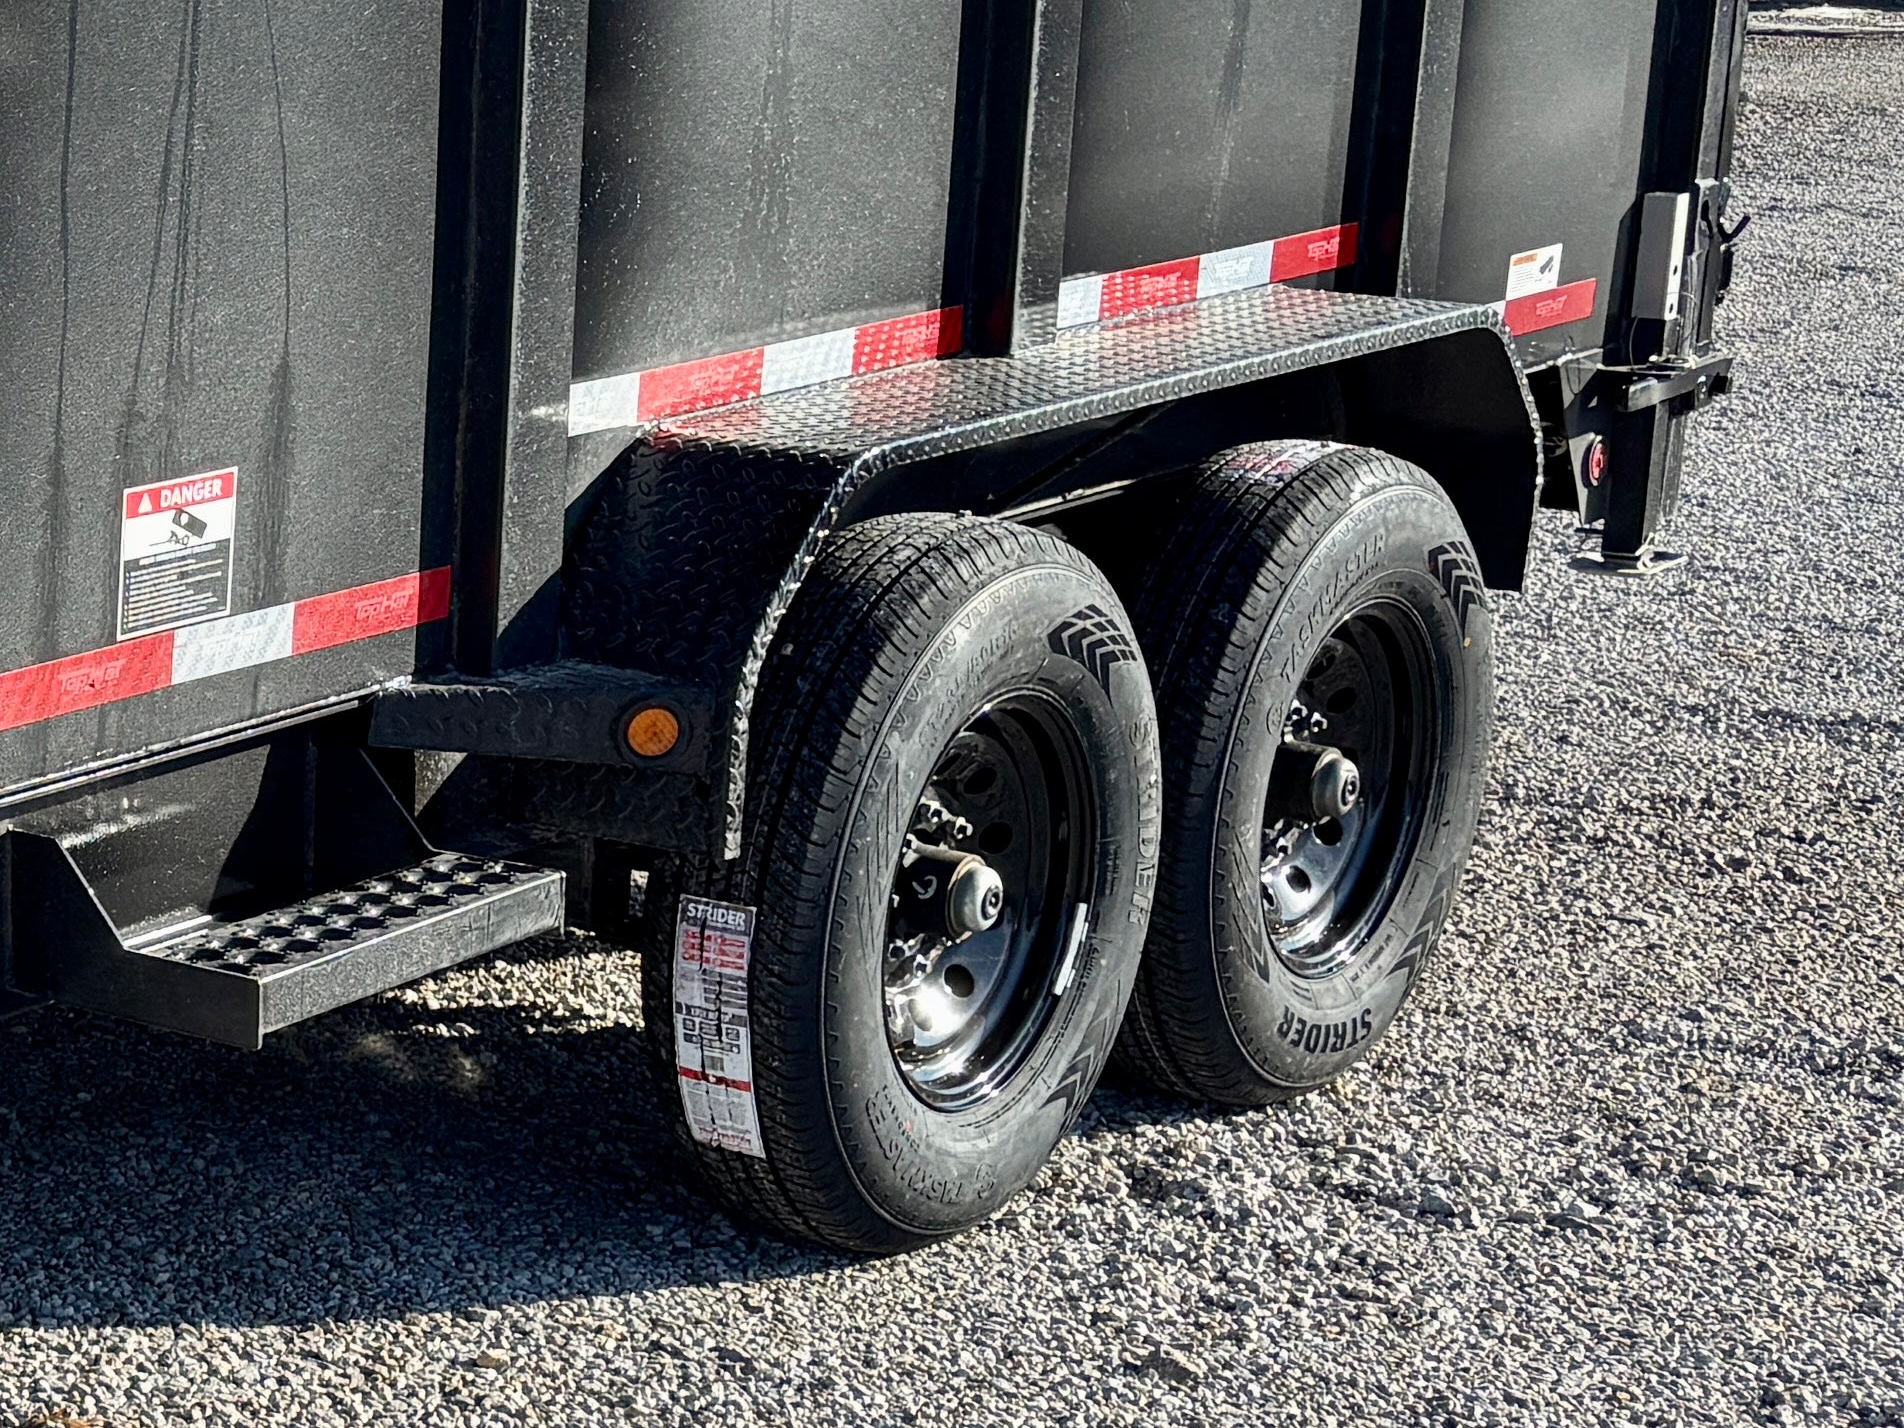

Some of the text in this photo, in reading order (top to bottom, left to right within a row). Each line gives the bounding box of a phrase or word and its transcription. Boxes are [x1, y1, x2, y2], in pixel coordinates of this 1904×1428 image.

[160, 478, 223, 508] DANGER
[686, 902, 747, 926] STRIDER
[1276, 1005, 1373, 1055] STRIDER
